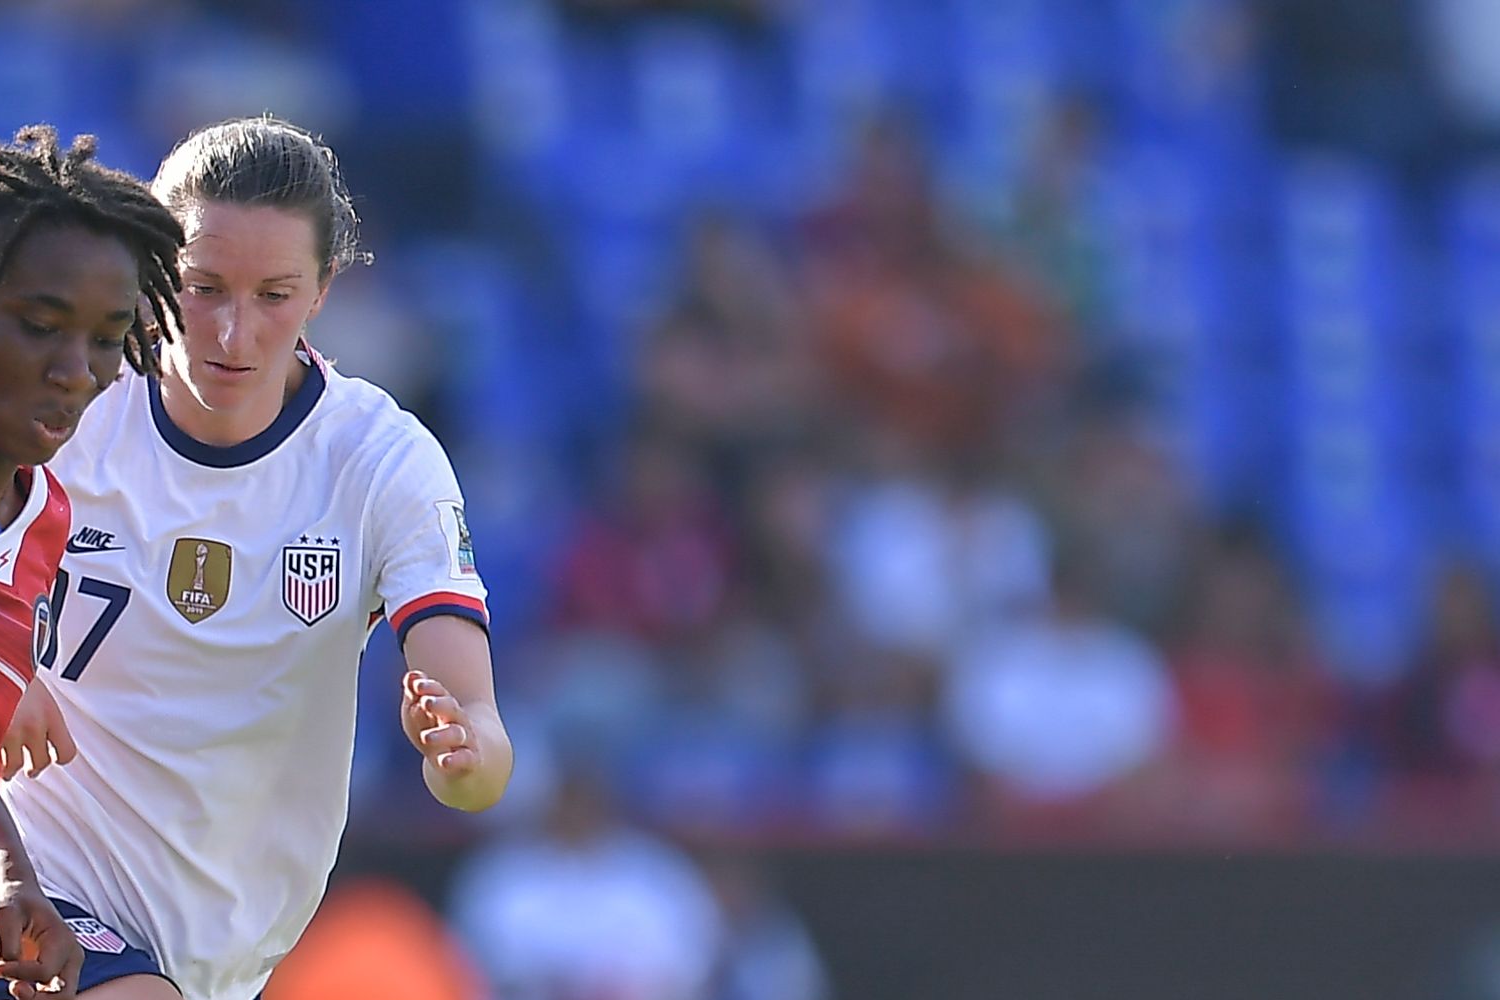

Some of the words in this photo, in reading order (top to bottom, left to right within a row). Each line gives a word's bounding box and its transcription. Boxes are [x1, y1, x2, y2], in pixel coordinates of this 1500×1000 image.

[75, 526, 116, 549] NIKE
[288, 553, 334, 580] USA
[181, 590, 211, 605] FIFA
